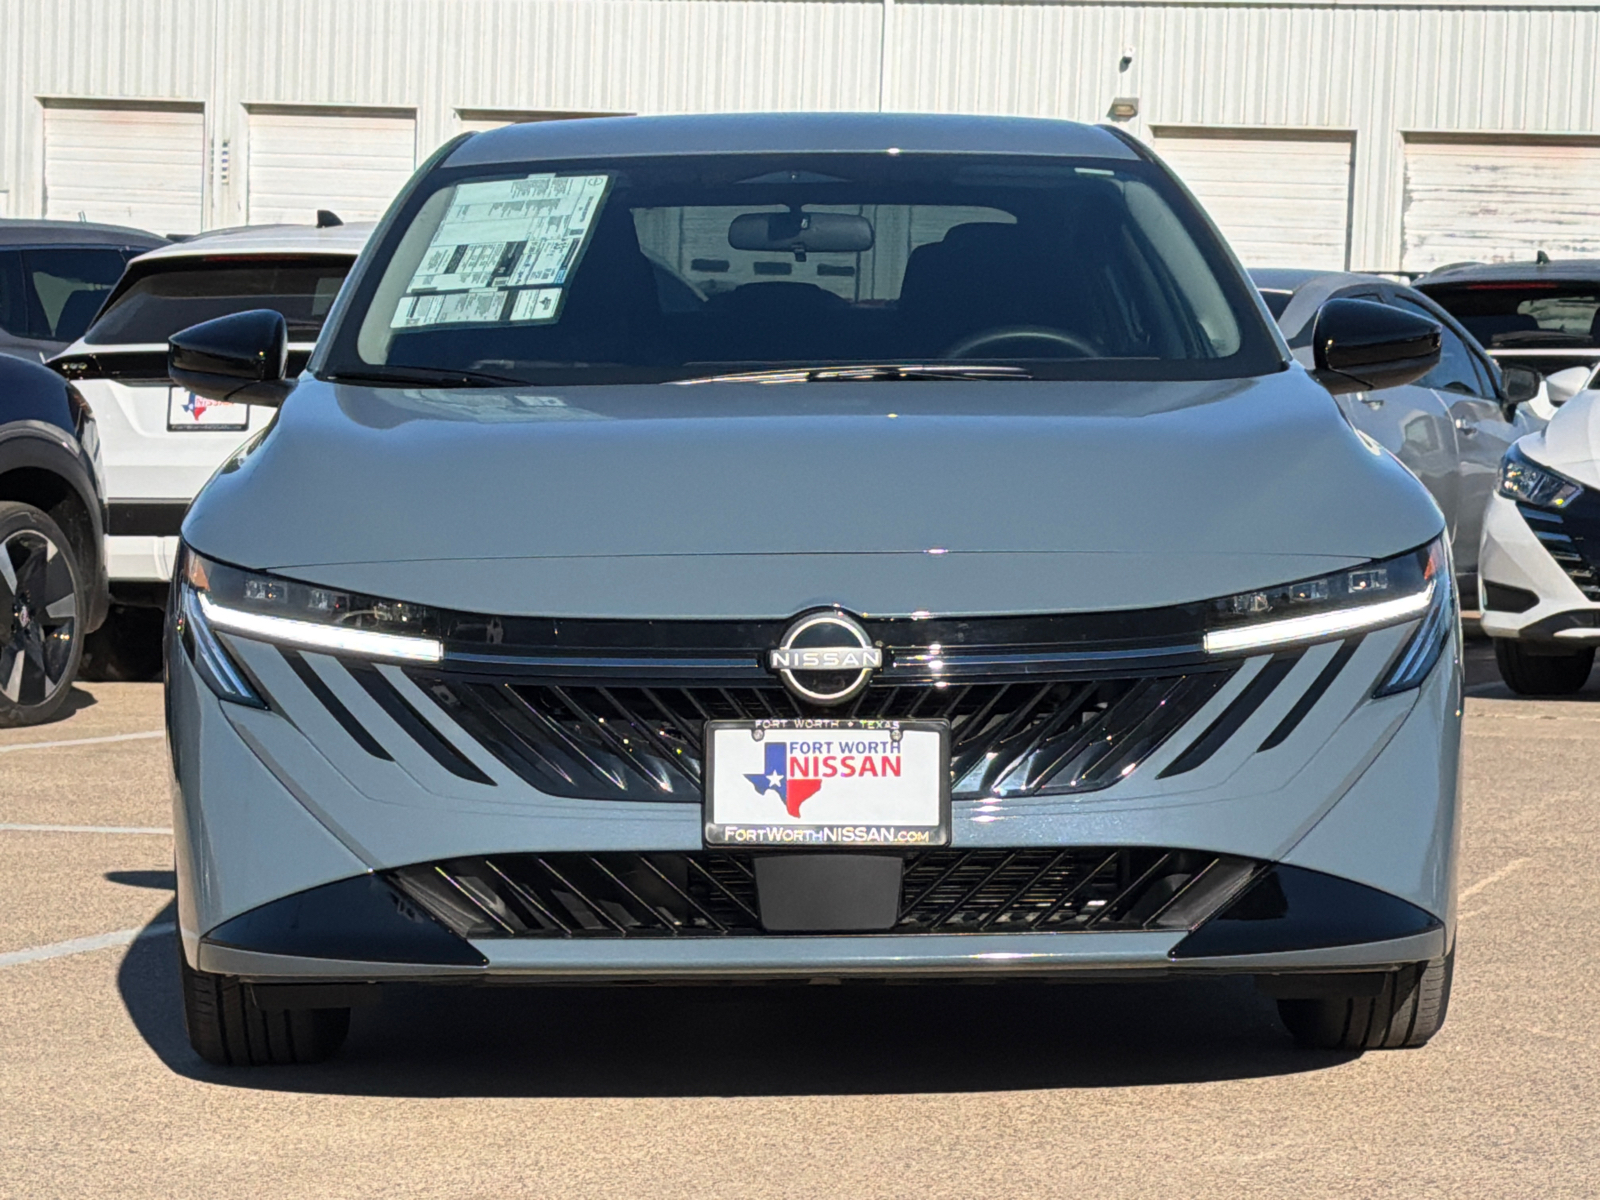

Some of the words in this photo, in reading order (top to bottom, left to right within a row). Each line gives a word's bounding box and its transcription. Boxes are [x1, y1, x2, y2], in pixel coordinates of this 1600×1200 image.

[772, 652, 880, 667] NISSAN
[755, 719, 787, 729] FORT
[795, 719, 839, 729] WORTH
[860, 719, 900, 729] TEXAS
[789, 741, 834, 755] FORT
[839, 741, 901, 755] WORTH
[789, 756, 902, 778] NISSAN
